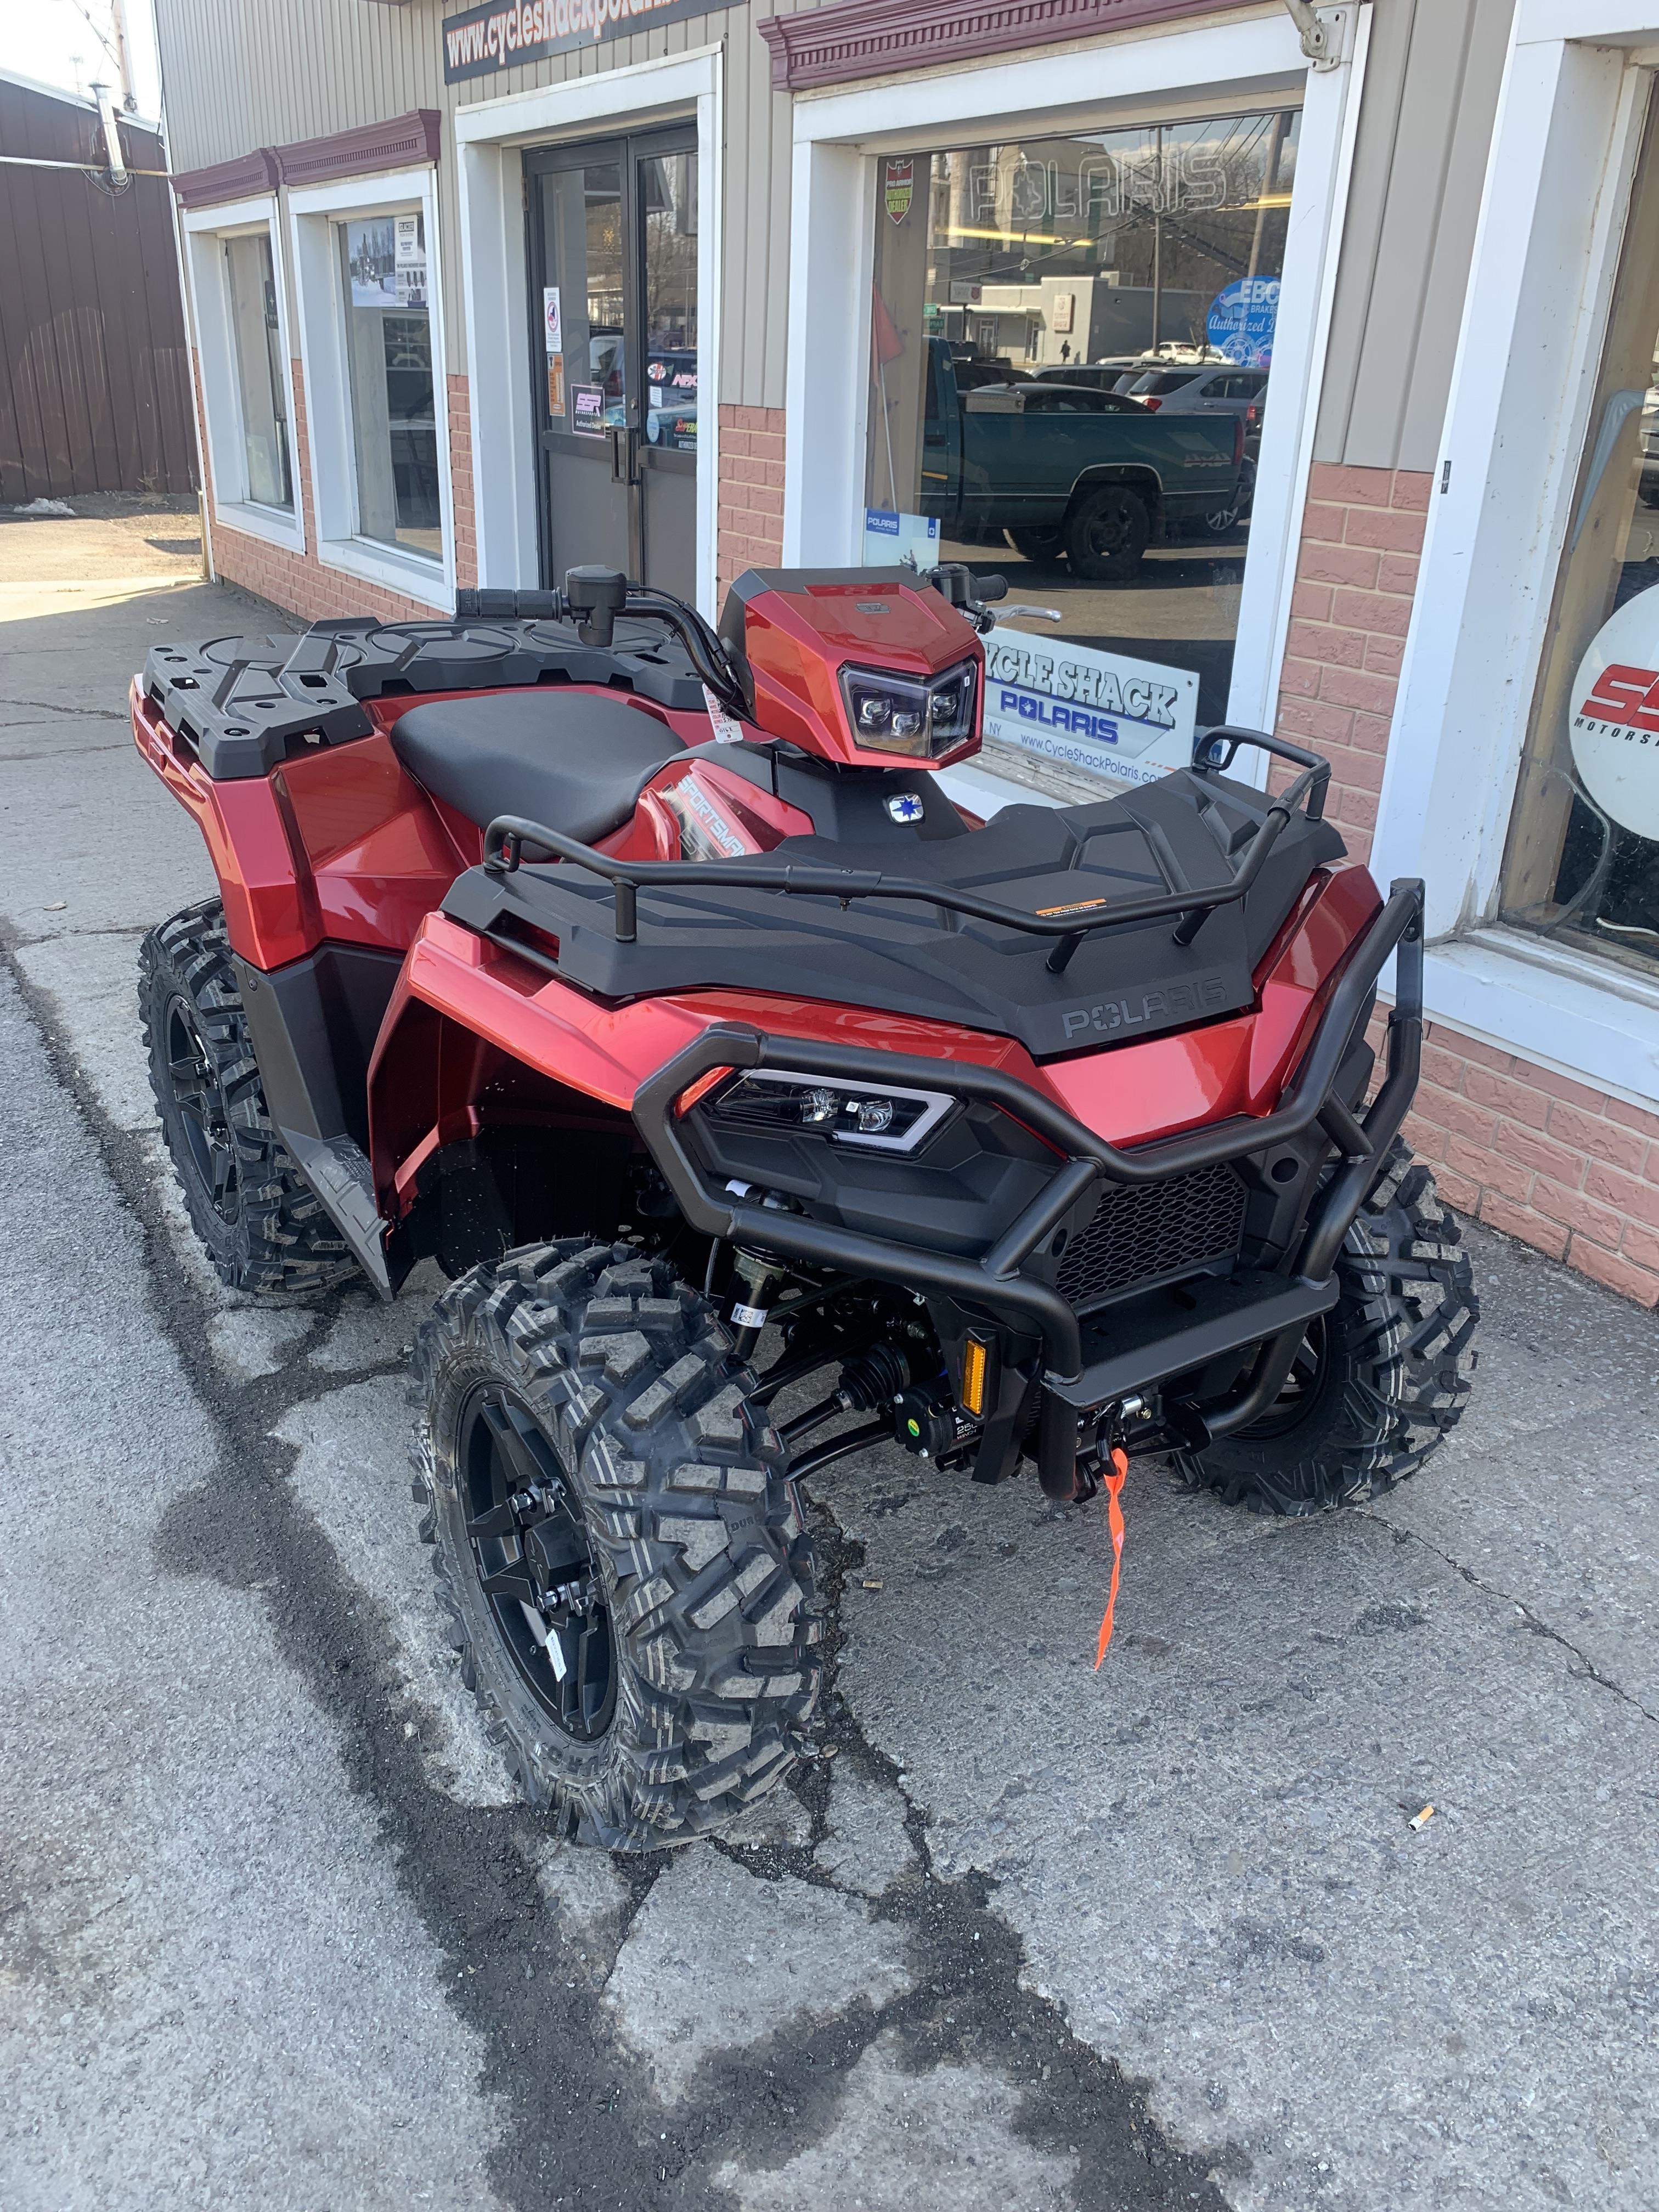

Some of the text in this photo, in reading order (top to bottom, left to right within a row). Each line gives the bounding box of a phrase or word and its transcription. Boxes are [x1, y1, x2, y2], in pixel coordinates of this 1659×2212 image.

[970, 149, 1227, 221] POLARIS
[888, 199, 908, 213] DEALER
[1240, 280, 1281, 304] EBC
[1251, 305, 1278, 314] BRAKES
[1209, 315, 1266, 332] Authorized
[868, 517, 898, 529] POLARIS
[982, 640, 1178, 729] YCLE SHACK
[989, 721, 1002, 736] NY
[1001, 690, 1119, 745] POLARIS
[1574, 717, 1659, 747] MOTORS
[1062, 977, 1227, 1039] POLARIS
